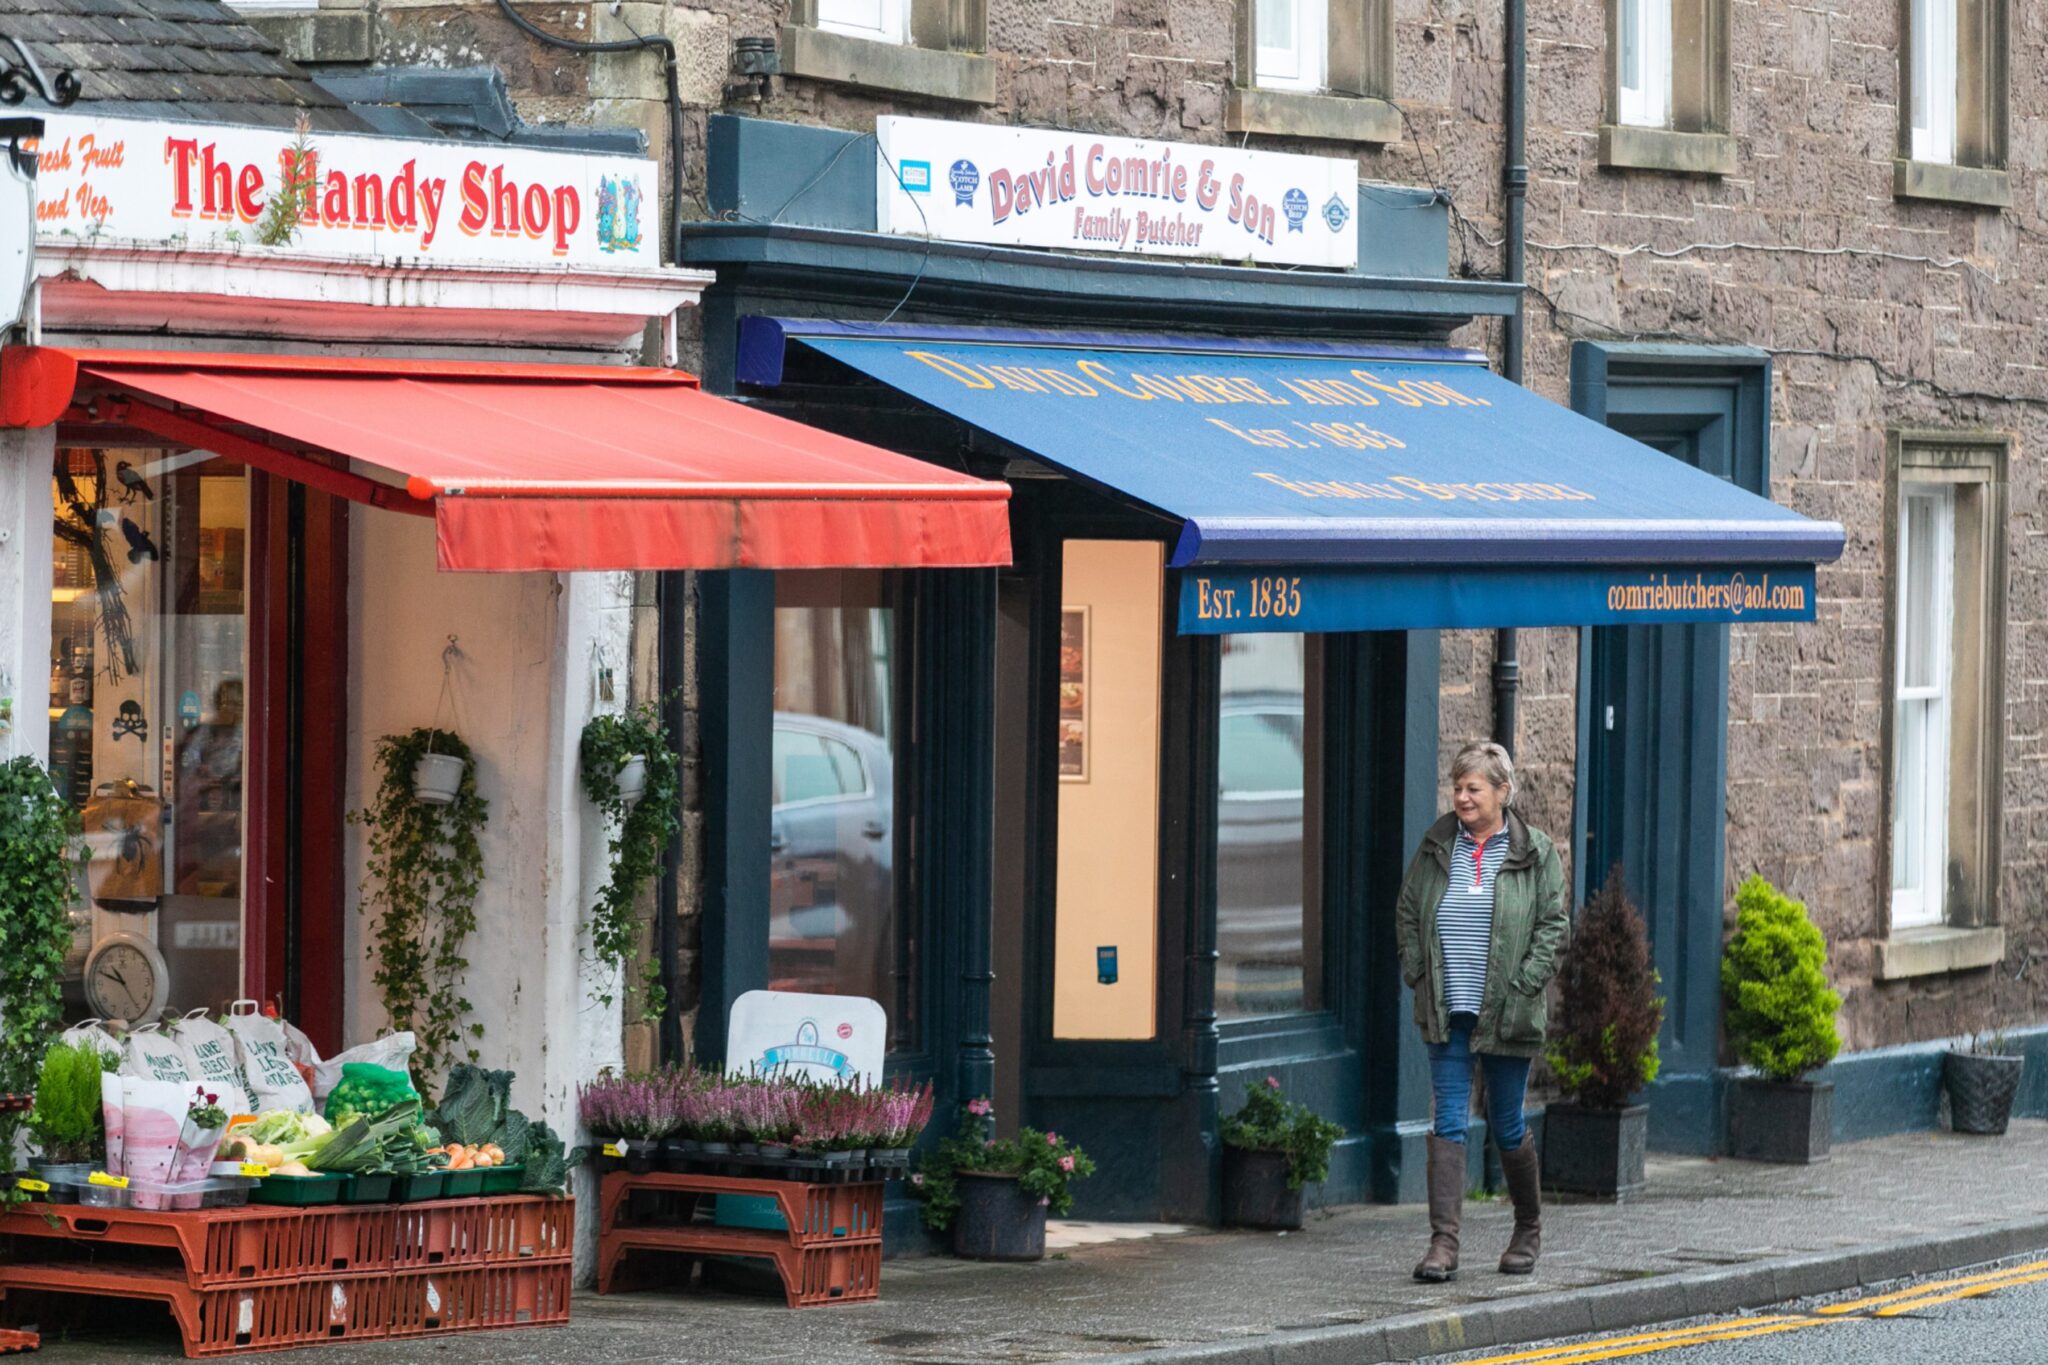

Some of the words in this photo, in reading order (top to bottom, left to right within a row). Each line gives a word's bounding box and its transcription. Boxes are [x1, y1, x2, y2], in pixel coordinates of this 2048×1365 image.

[78, 133, 125, 177] Fruit
[36, 187, 70, 222] and
[76, 182, 114, 225] Veg.
[164, 136, 265, 222] The
[279, 147, 447, 251] Handy
[458, 159, 581, 256] Shop
[989, 144, 1077, 226] David
[1086, 143, 1188, 204] Comrie
[1196, 159, 1222, 212] &
[1228, 172, 1275, 246] Son
[1073, 206, 1132, 250] Family
[1136, 210, 1204, 248] Butcher
[1249, 577, 1301, 617] 1835
[1607, 572, 1805, 615] comriebutchers@aol.com
